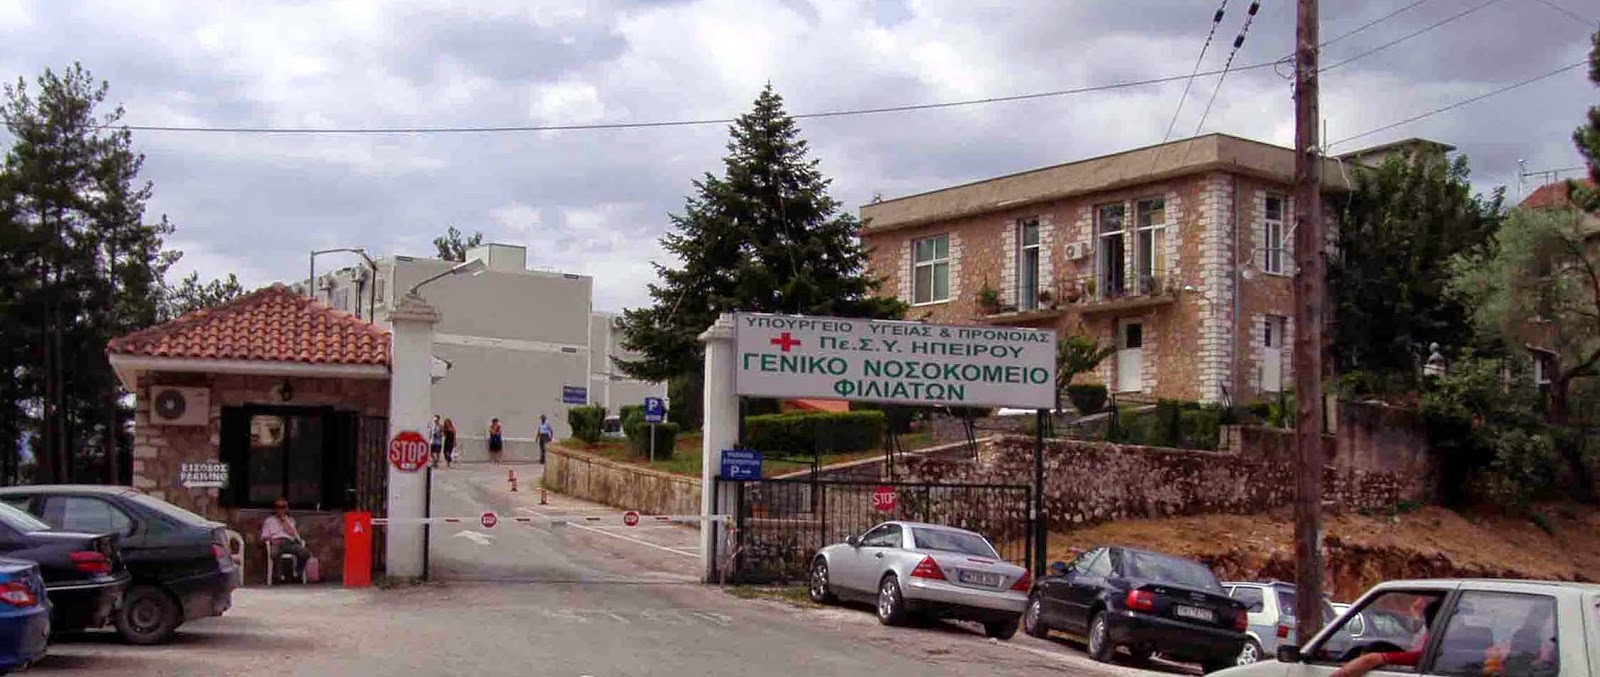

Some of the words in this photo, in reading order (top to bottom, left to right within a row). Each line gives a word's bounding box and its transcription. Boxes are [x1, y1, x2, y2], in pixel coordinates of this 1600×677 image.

[745, 316, 853, 333] ΥΠΟΥΡΓΕΙΟ
[869, 323, 932, 337] ΥΓΕΙΑΣ
[939, 327, 951, 338] &
[958, 328, 1050, 343] ΠΡΟΝΟΙΑΣ
[911, 340, 1024, 358] ΗΠΕΙΡΟΥ
[743, 352, 848, 375] ΓΕΝΙΚΟ
[863, 358, 1050, 385] ΝΟΣΟΚΟΜΕΙΟ
[833, 378, 965, 400] ΦΙΛΙΑΤΩΝ
[648, 399, 659, 412] P
[391, 440, 428, 463] STOP
[730, 465, 740, 478] P
[873, 492, 896, 505] STOP
